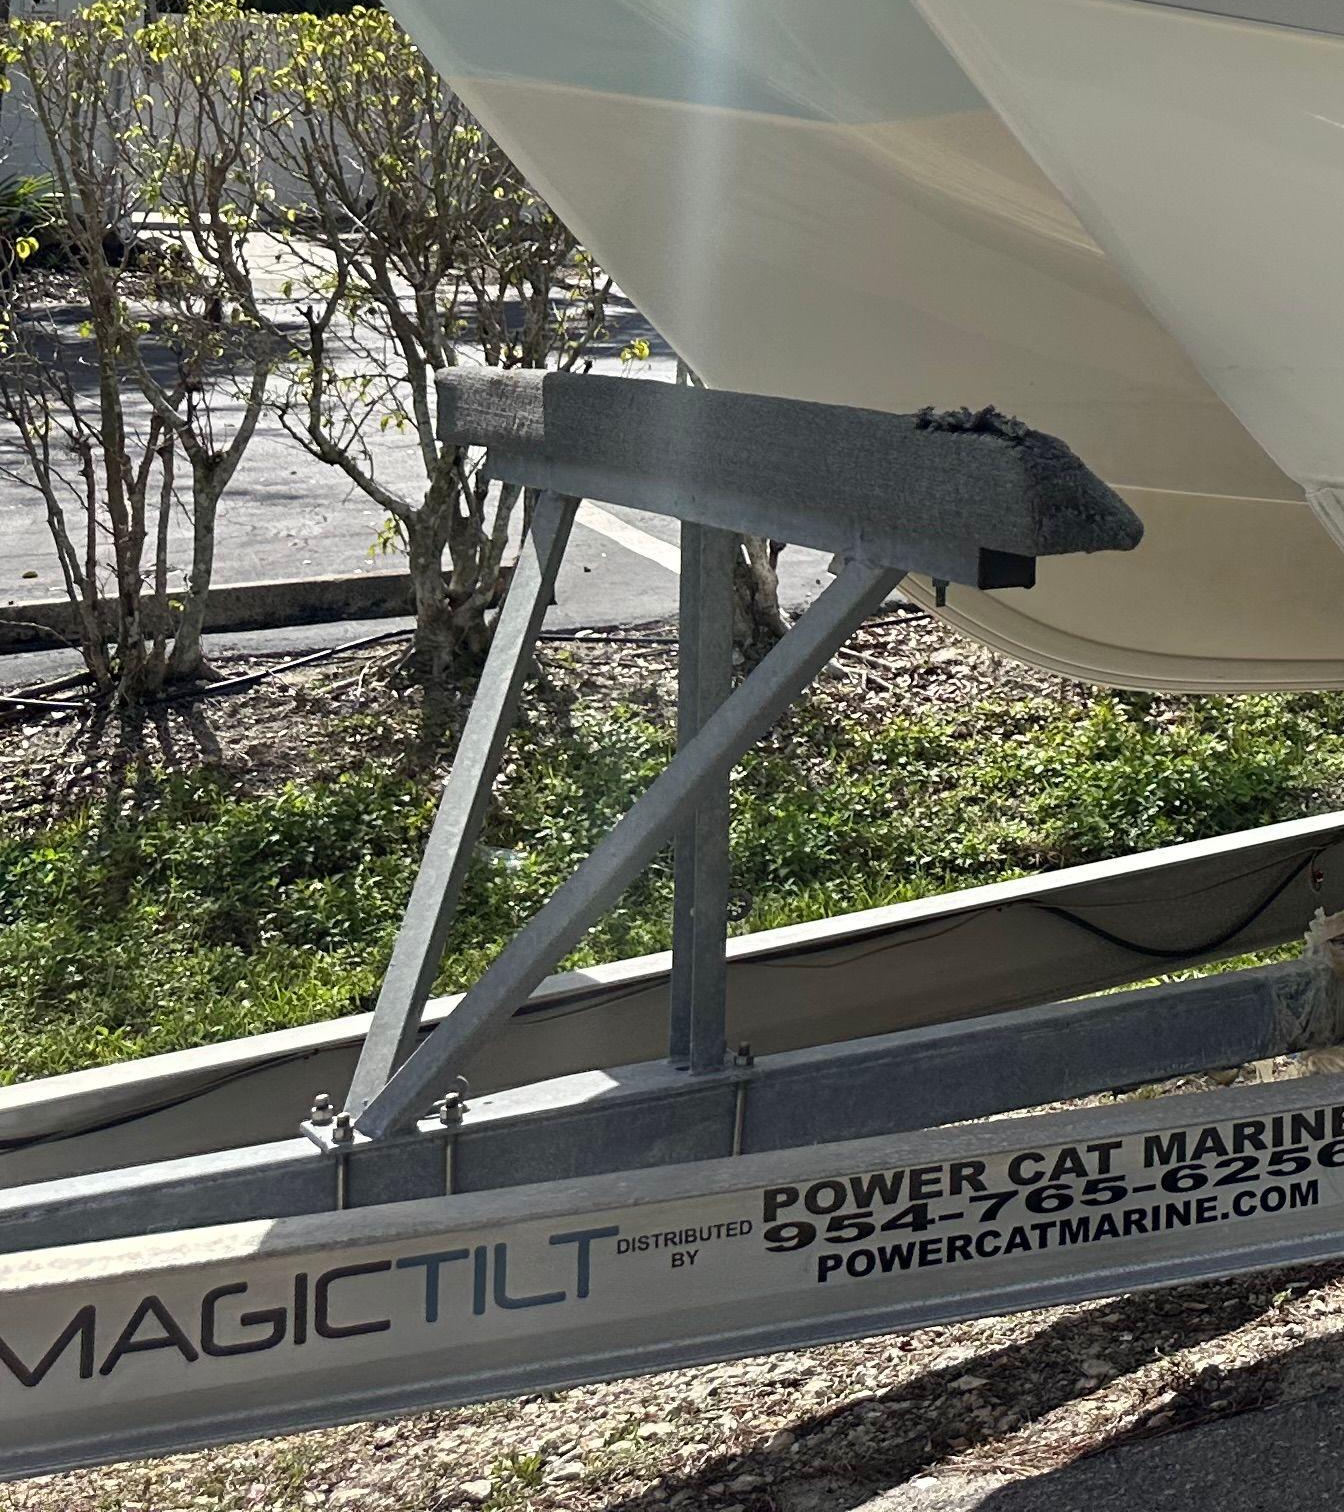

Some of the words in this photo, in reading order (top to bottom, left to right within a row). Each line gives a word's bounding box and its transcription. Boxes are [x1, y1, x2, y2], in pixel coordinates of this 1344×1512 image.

[763, 1159, 988, 1224] POWER
[1007, 1140, 1123, 1186] CAT
[616, 1219, 753, 1255] DISTRIBUTED
[671, 1249, 700, 1269] BY
[817, 1179, 1319, 1283] POWERCATMARINE.COM
[0, 1225, 620, 1387] MAGICTILT
